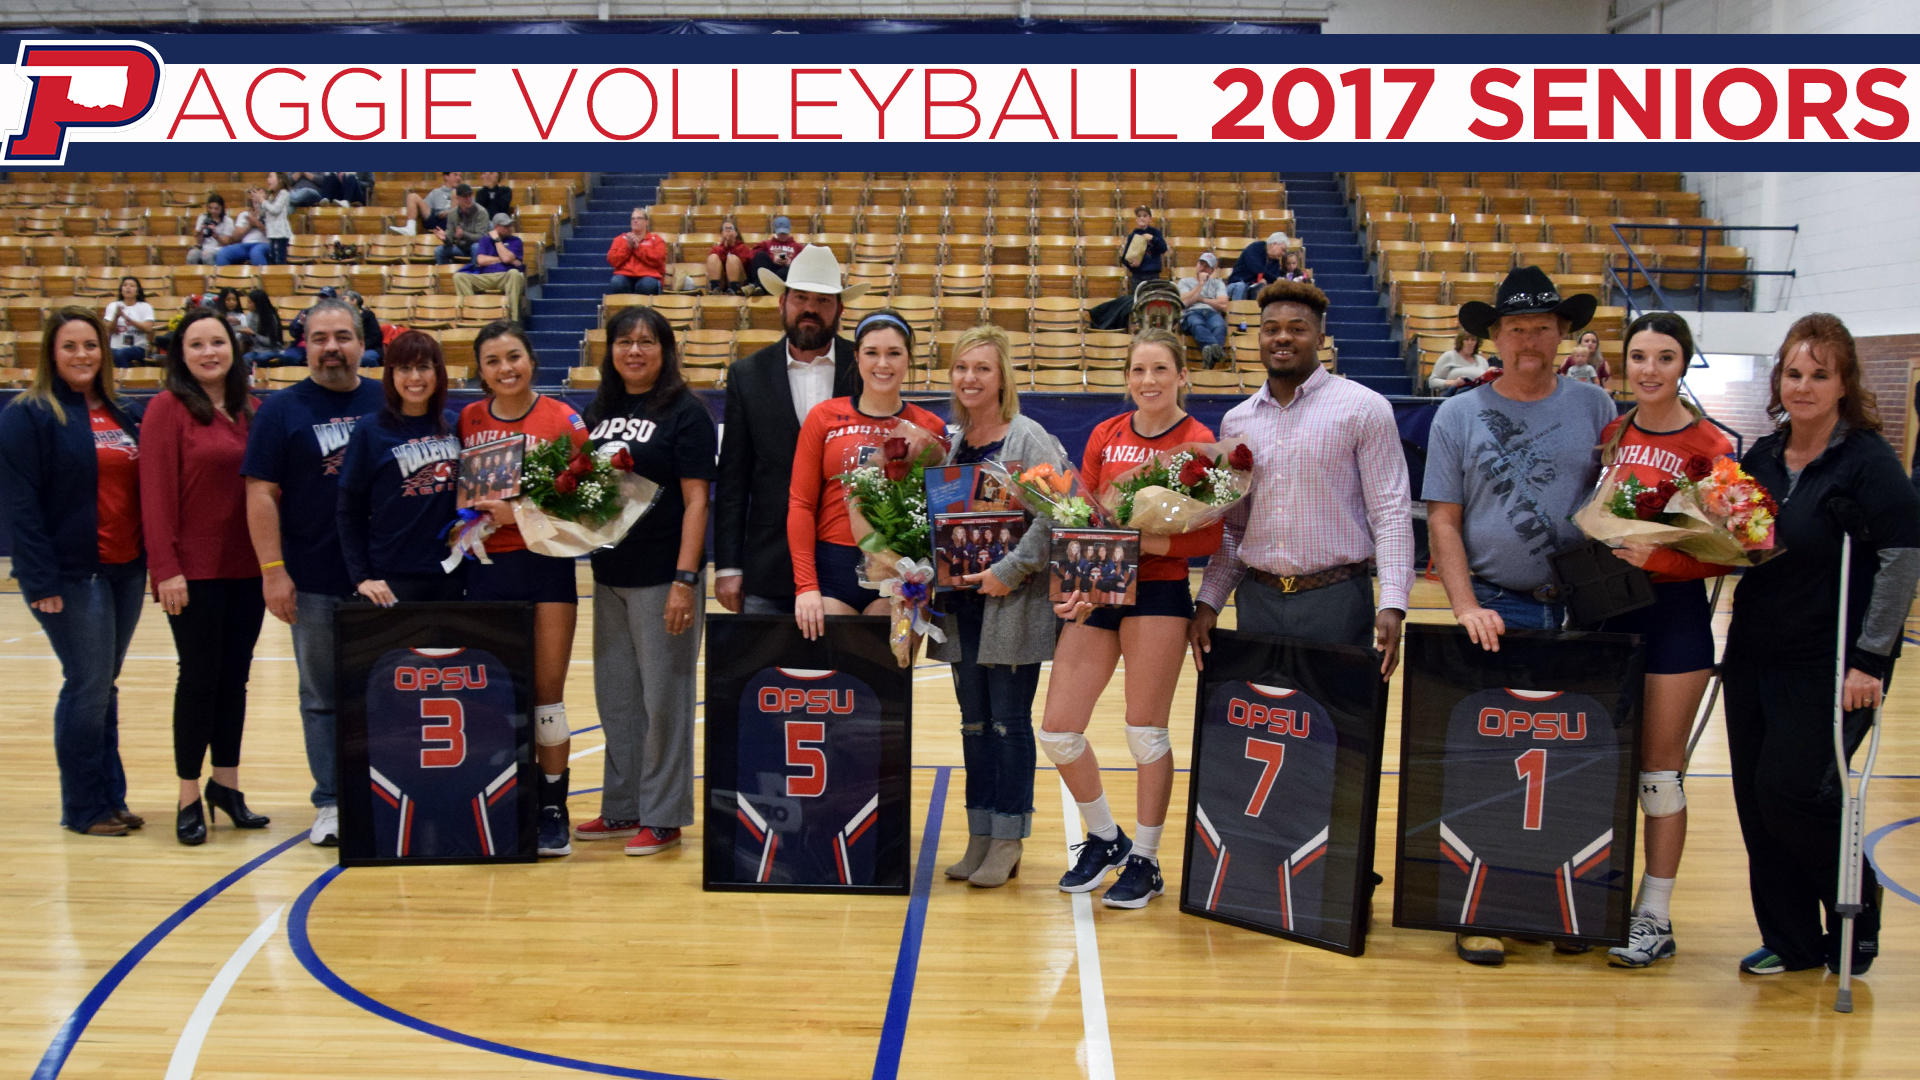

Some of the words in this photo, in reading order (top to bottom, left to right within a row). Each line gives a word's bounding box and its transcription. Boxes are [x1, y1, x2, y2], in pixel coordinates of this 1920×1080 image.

[589, 417, 657, 444] OPSU
[393, 664, 488, 692] OPSU
[757, 686, 855, 715] OPSU
[1226, 697, 1311, 739] OPSU
[419, 697, 466, 769] 3
[1477, 707, 1587, 741] OPSU
[784, 720, 828, 798] 5
[1243, 736, 1286, 818] 7
[1514, 748, 1547, 831] 1
